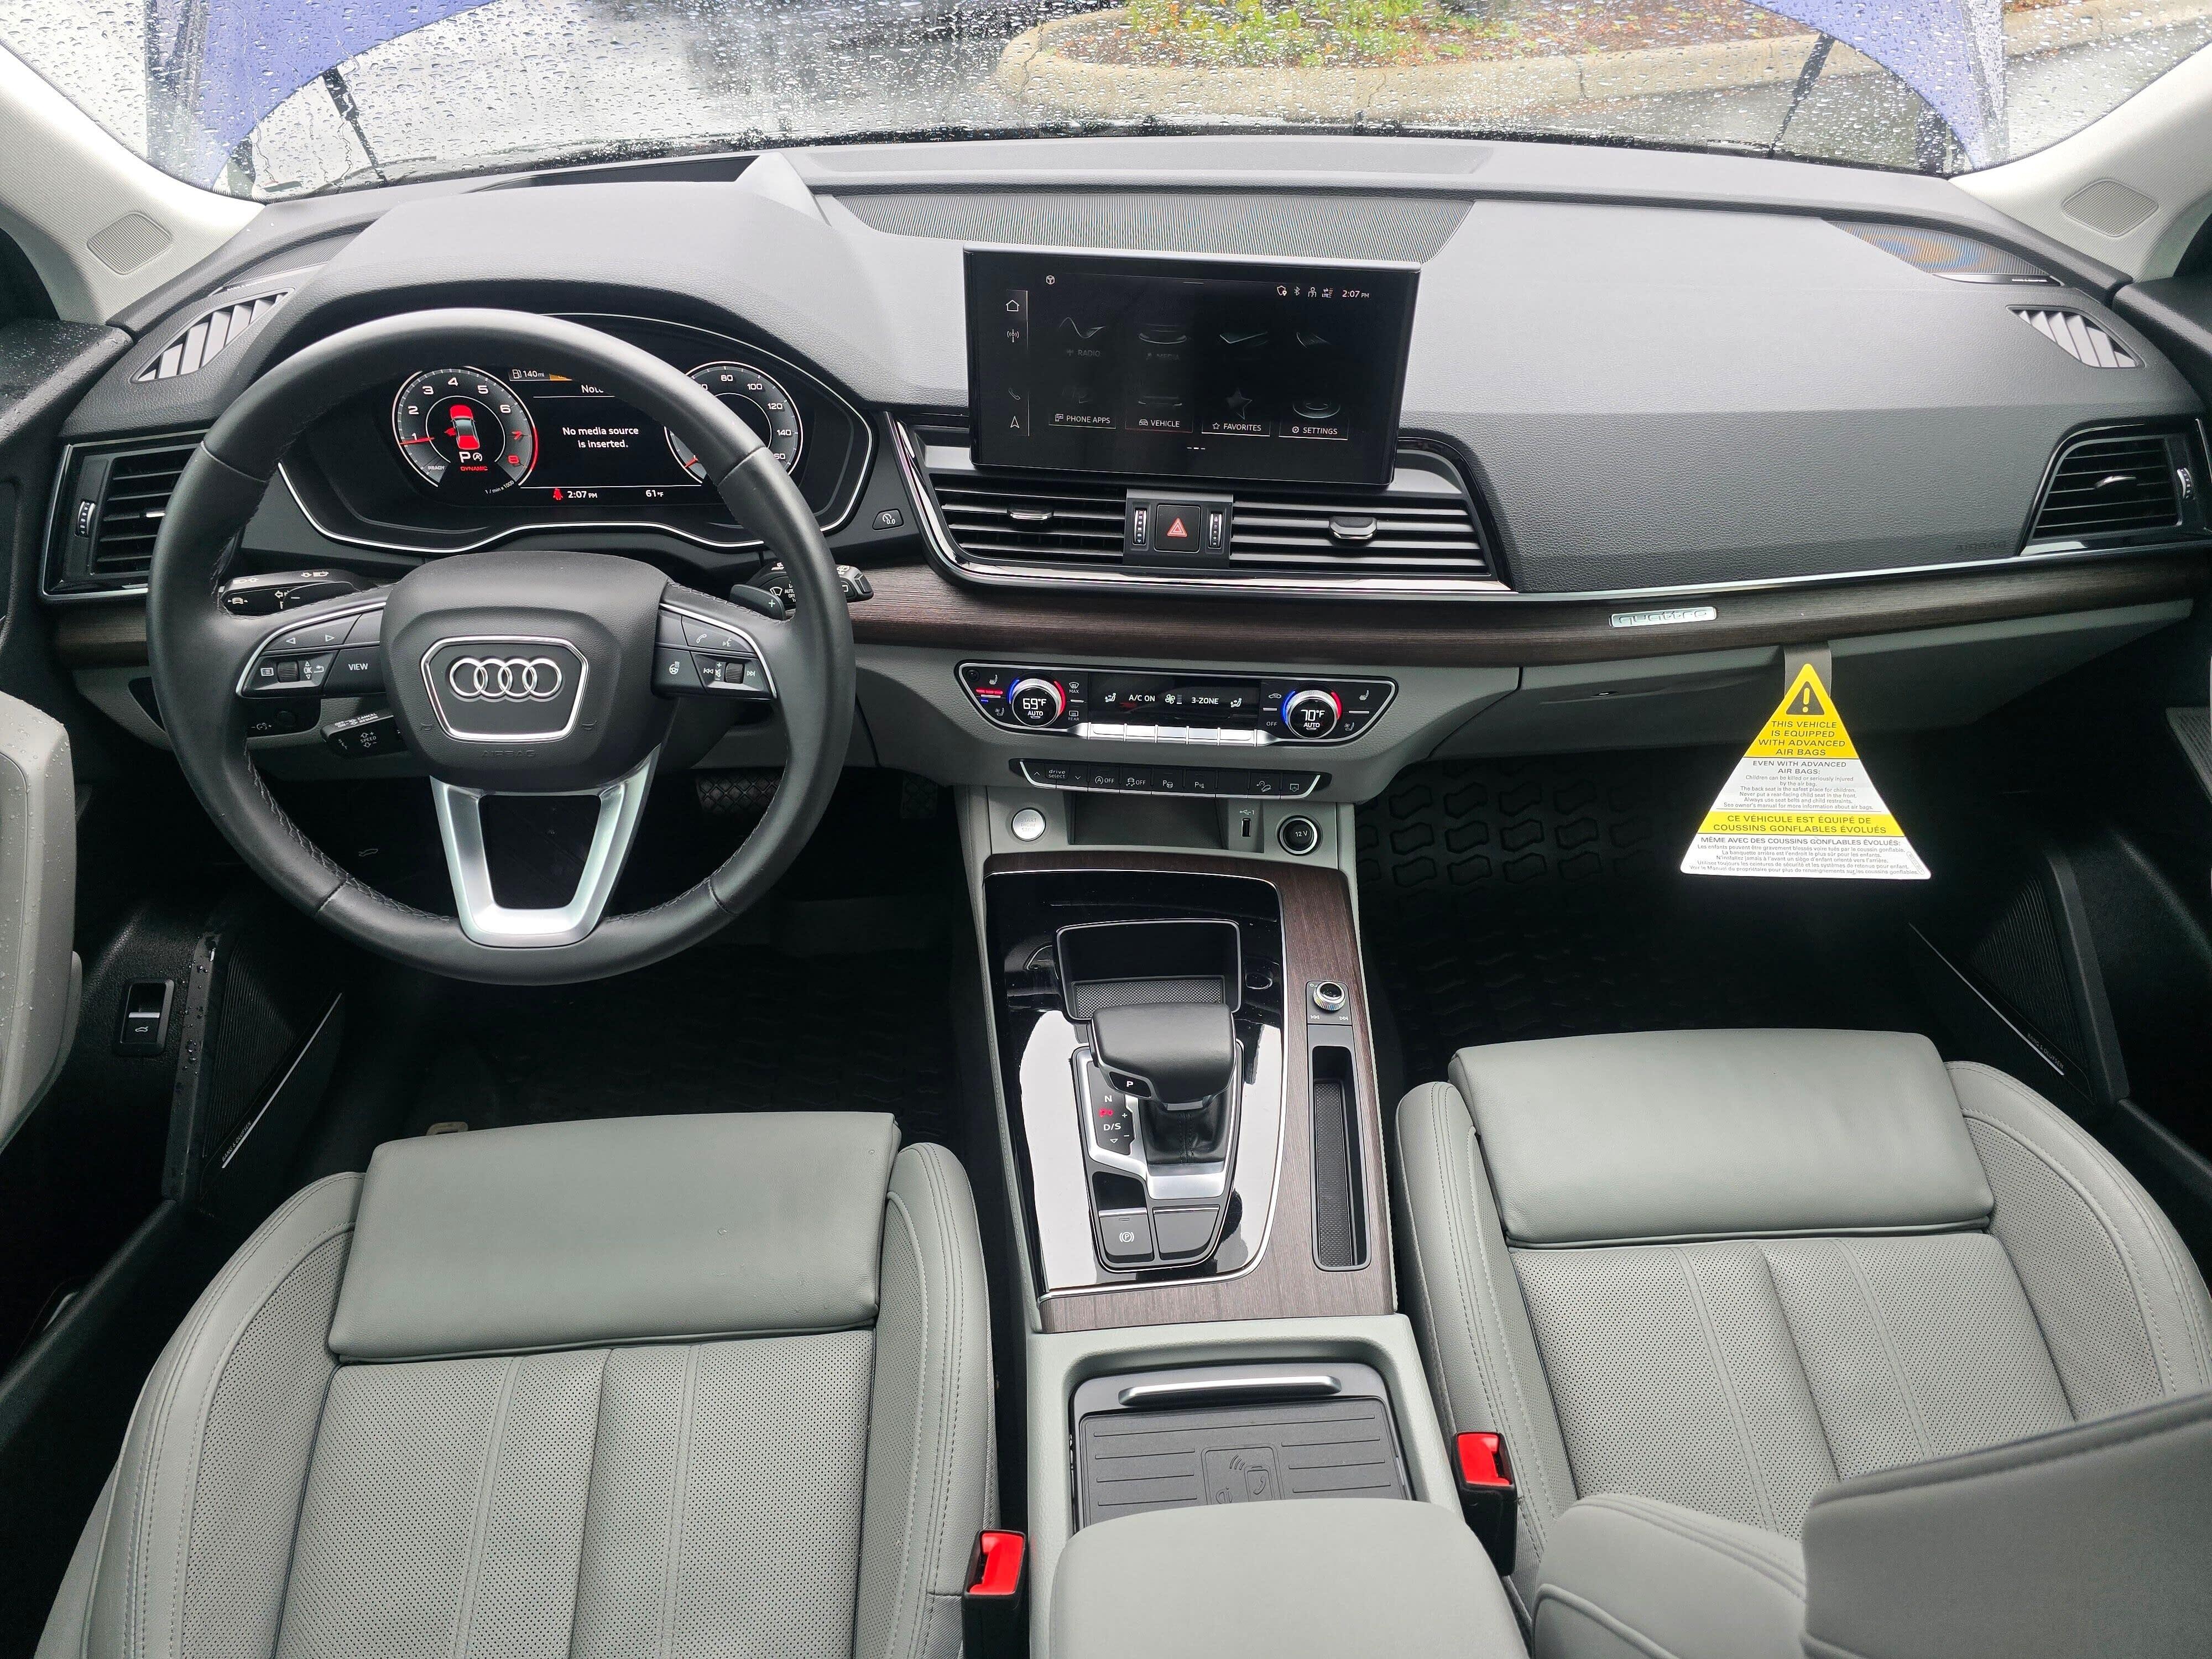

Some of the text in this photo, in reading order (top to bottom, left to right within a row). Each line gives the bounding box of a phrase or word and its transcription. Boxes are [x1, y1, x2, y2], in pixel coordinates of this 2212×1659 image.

[1078, 349, 1100, 358] RADIO
[448, 377, 458, 386] 4
[422, 386, 434, 395] 3
[478, 385, 488, 394] 5
[408, 406, 419, 415] 2
[500, 405, 511, 414] 6
[562, 427, 576, 436] No
[578, 427, 607, 435] media
[1224, 423, 1261, 431] FAVORITES
[511, 431, 523, 440] 7
[588, 440, 628, 448] inserted.
[459, 451, 471, 462] P
[508, 455, 520, 464] 8
[1619, 611, 1707, 625] quattro
[1103, 1123, 1121, 1131] D/S
